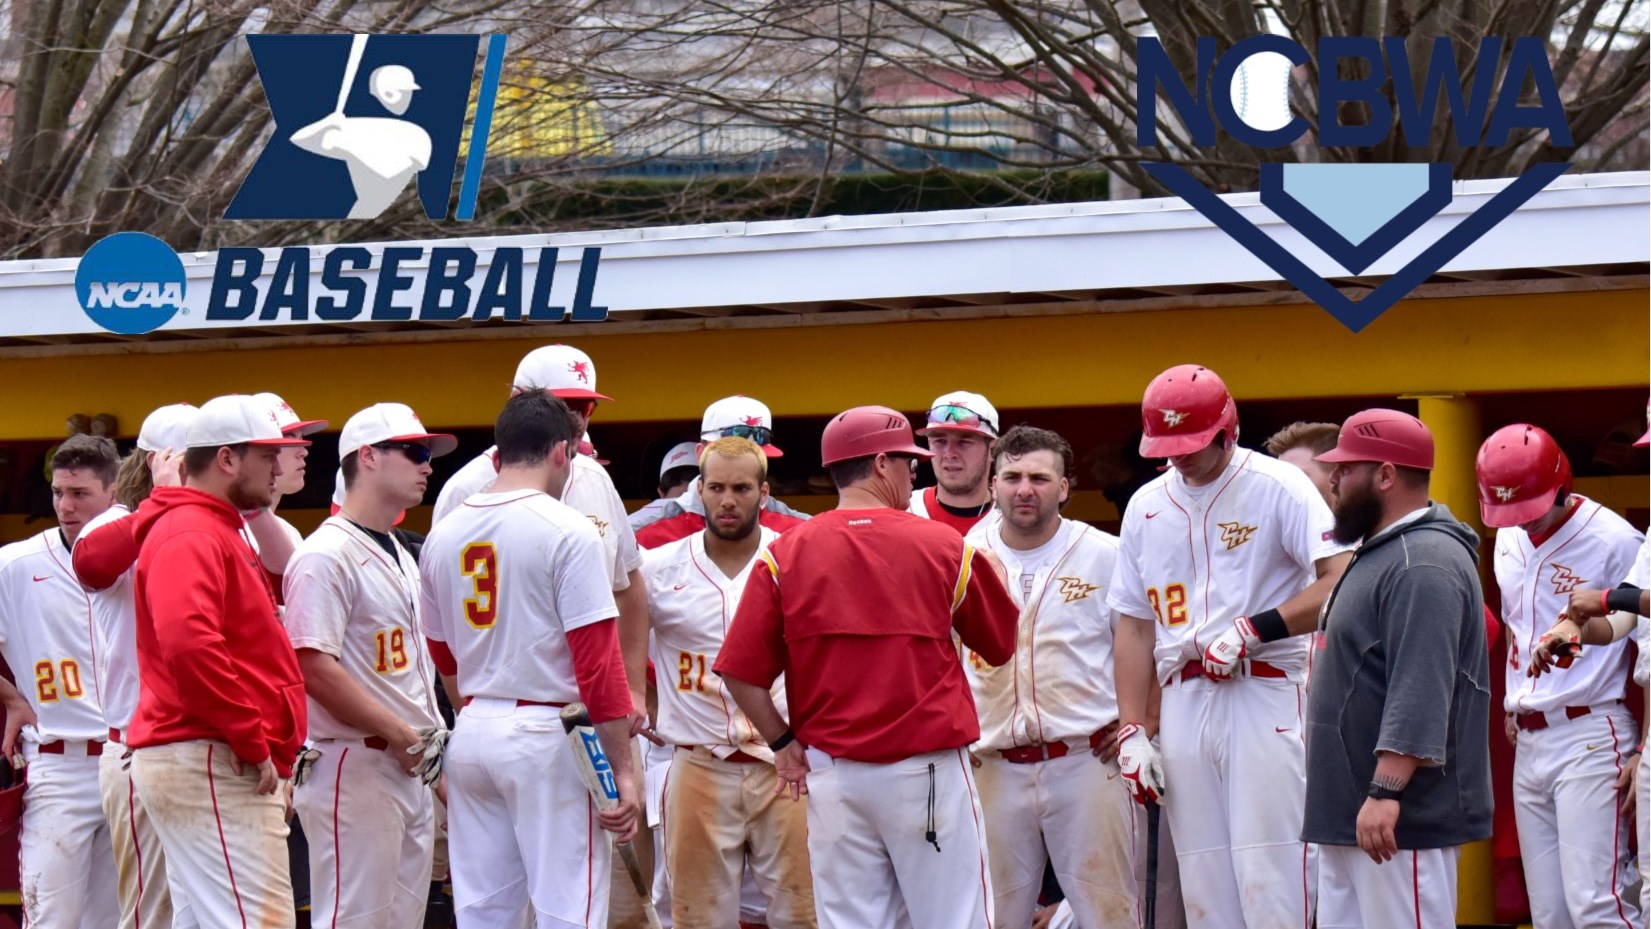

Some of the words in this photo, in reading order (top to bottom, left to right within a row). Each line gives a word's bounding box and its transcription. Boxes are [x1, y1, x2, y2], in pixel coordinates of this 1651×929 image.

[461, 541, 498, 629] 3
[375, 626, 408, 673] 19
[676, 650, 707, 693] 21
[35, 658, 84, 702] 20
